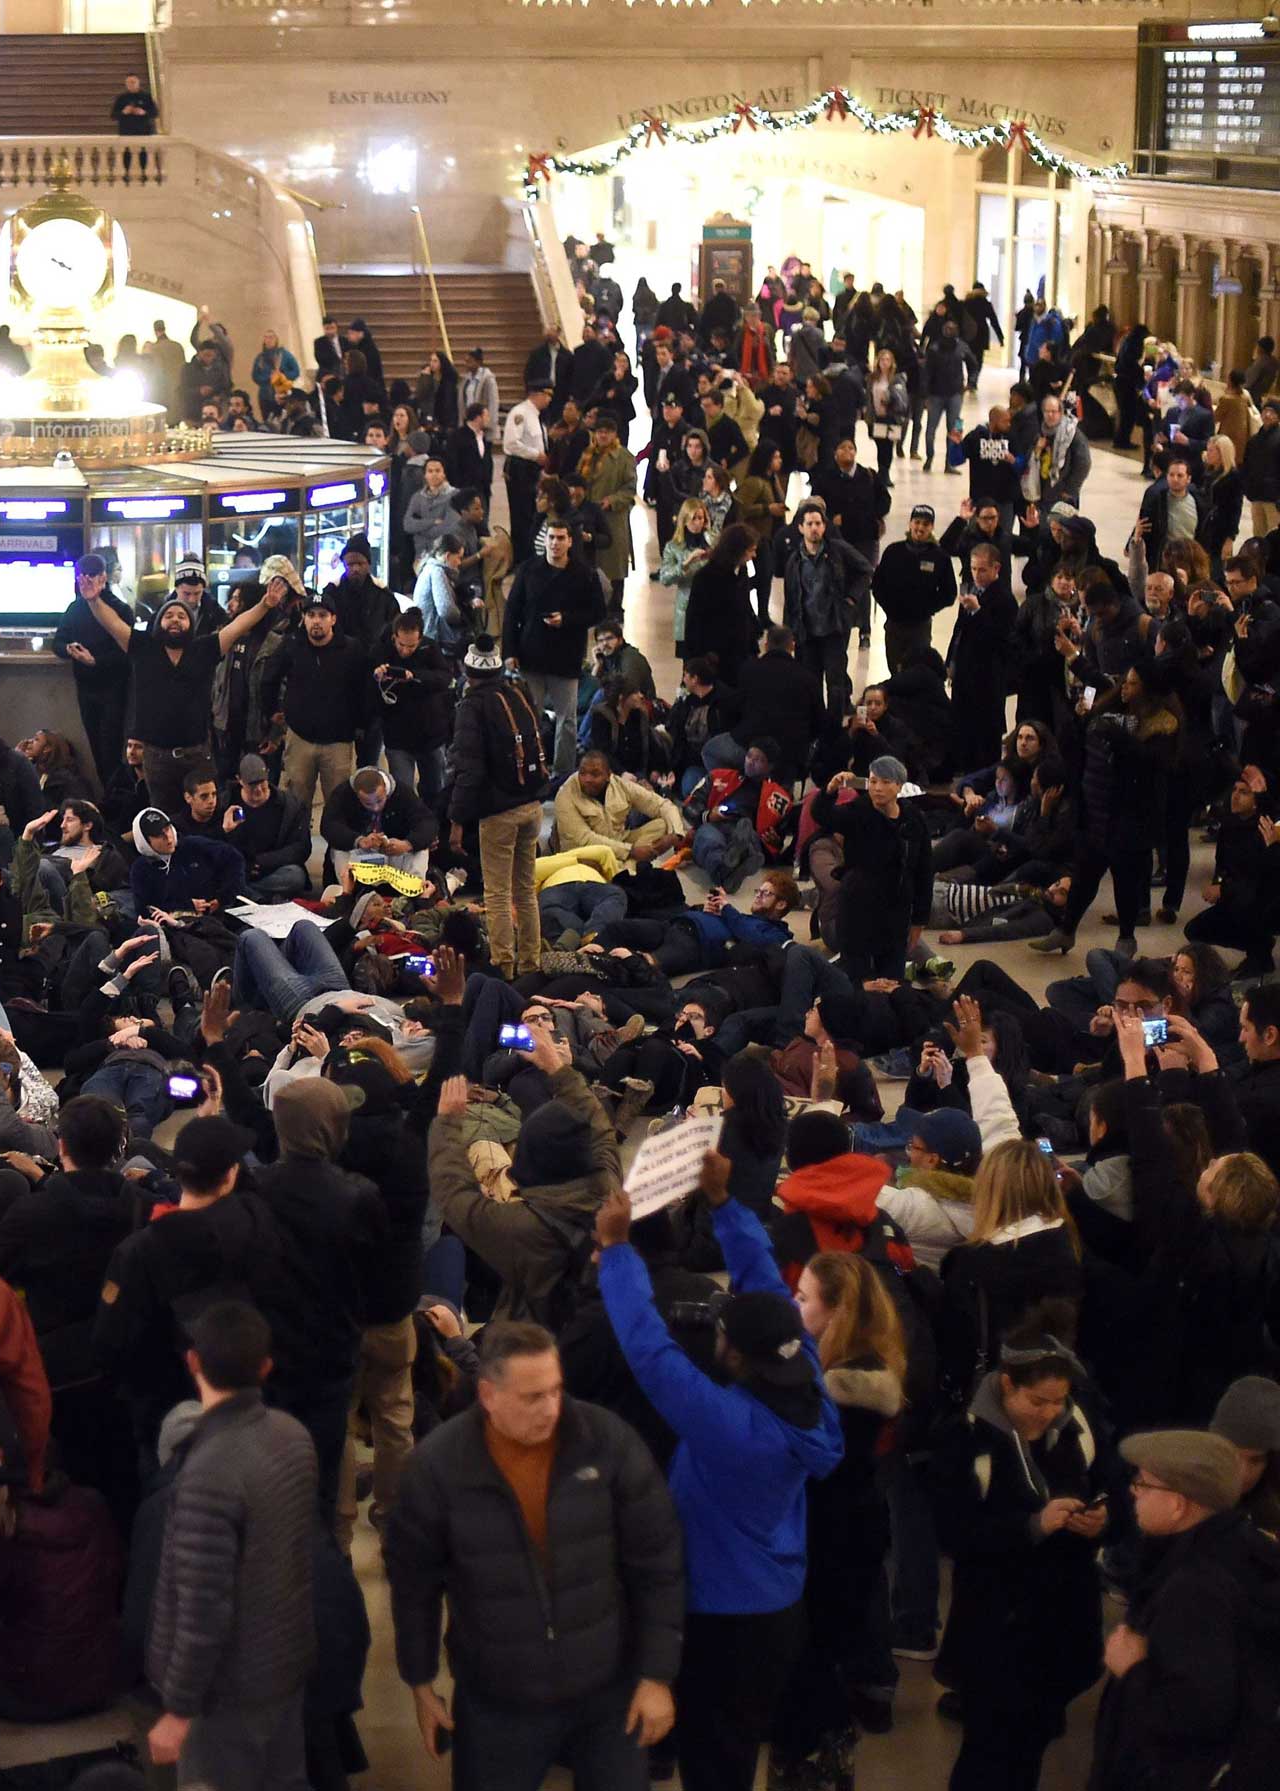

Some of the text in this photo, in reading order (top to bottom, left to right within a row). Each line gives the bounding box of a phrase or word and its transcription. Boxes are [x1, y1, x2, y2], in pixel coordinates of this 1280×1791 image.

[328, 90, 451, 104] EAST BALCONY
[617, 86, 794, 130] LEXINGTON AVE
[875, 87, 1068, 135] TICKET MACHINES
[32, 420, 131, 438] Information
[0, 538, 54, 550] ARRIVALS
[652, 1138, 675, 1154] LIVES
[677, 1125, 714, 1141] MATTER
[651, 1153, 674, 1169] LIVES
[676, 1139, 710, 1156] MATTER
[651, 1169, 675, 1186] LIVES
[677, 1158, 704, 1174] MATTE
